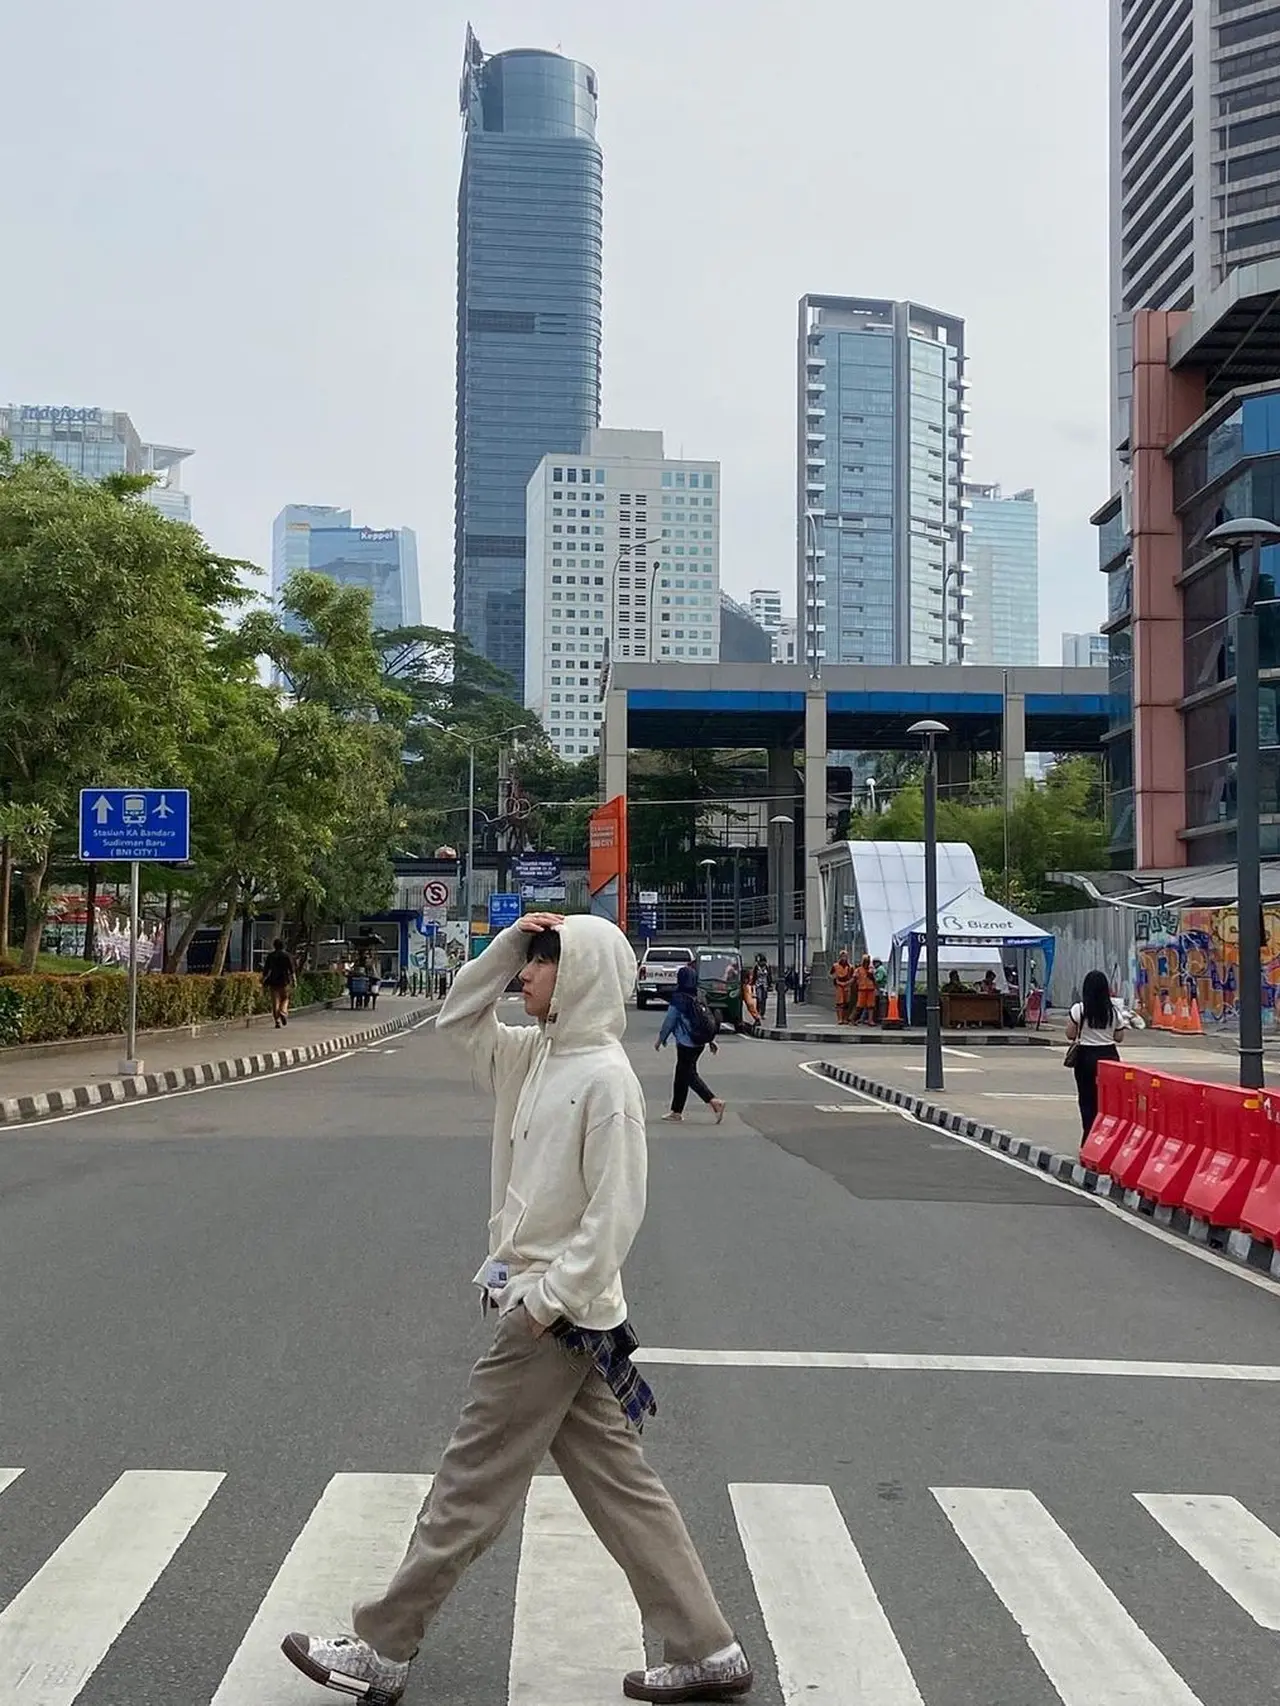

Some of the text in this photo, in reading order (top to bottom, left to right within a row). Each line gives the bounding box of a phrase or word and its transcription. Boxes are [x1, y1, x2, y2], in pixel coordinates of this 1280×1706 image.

[20, 405, 102, 425] Indofood
[93, 829, 176, 837] Stasiun KA Bandara
[102, 839, 167, 847] Sudirman Baru
[967, 919, 1014, 930] Biznet
